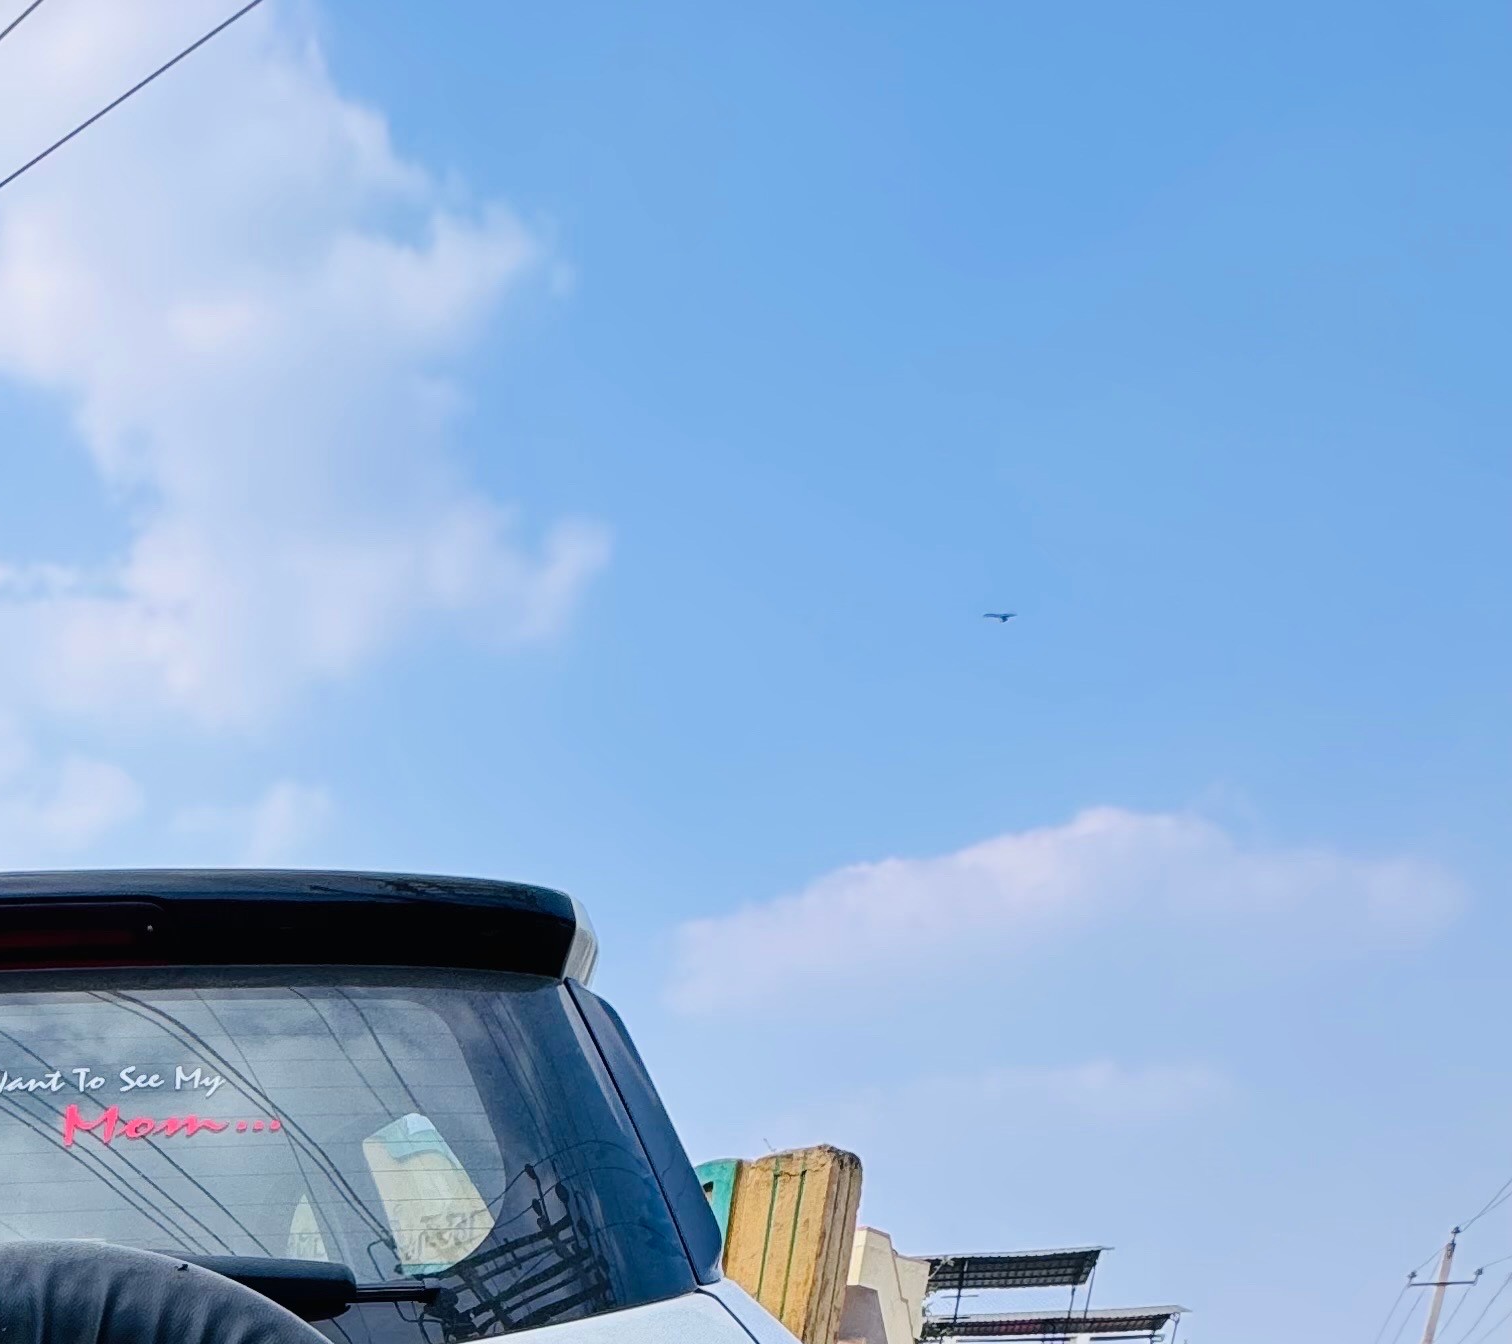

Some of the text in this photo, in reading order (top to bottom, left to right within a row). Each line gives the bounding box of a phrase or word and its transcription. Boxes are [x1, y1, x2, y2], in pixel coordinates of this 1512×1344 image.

[72, 1067, 107, 1091] To
[120, 1065, 164, 1091] See
[174, 1065, 226, 1098] My
